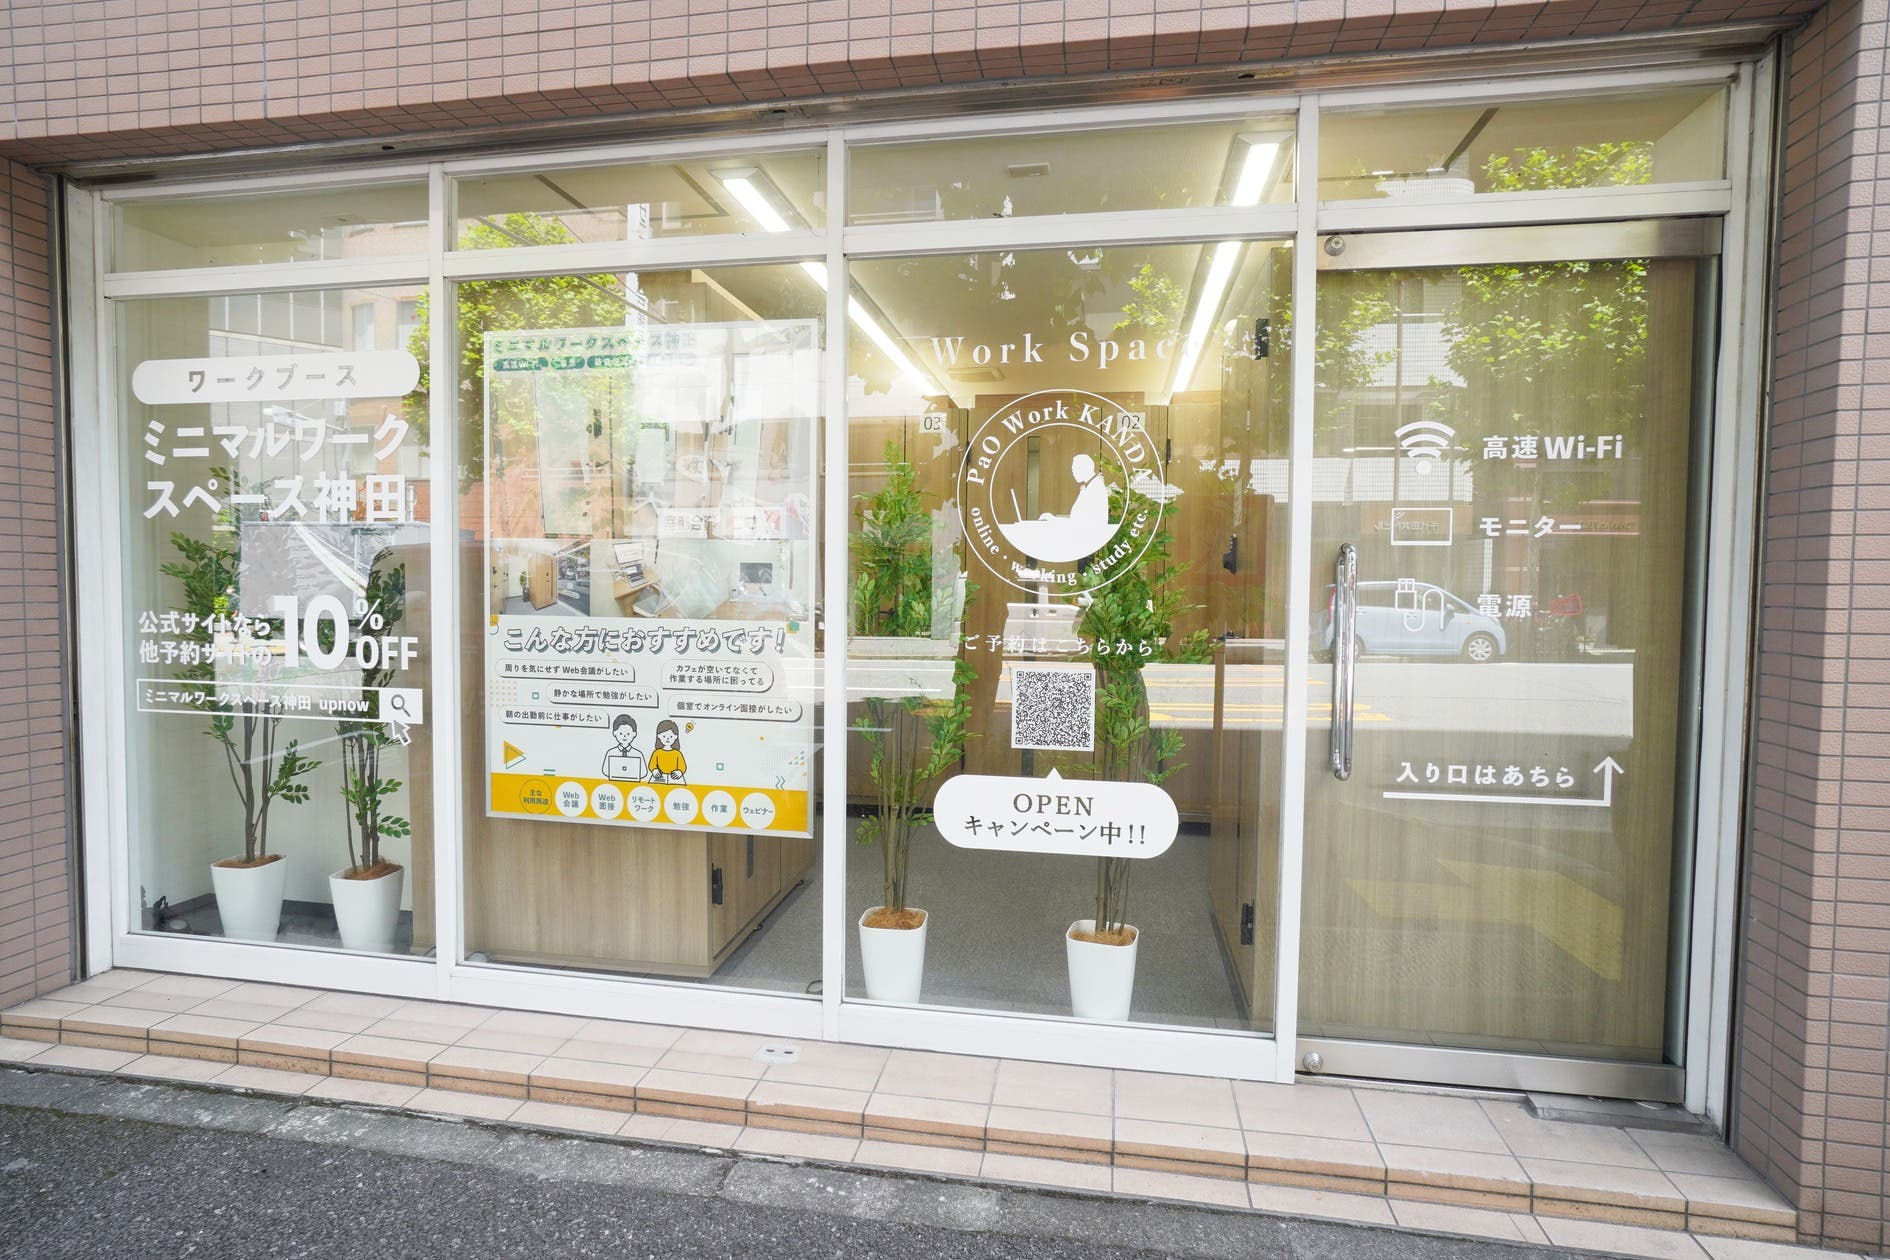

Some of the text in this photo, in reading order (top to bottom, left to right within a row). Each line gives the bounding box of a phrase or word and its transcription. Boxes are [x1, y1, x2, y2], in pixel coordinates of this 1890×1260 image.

[931, 333, 1044, 366] Work
[189, 363, 357, 392] ワークブース
[924, 417, 942, 431] 03
[1121, 415, 1141, 430] 02
[144, 414, 409, 466] ミニマルワーク
[967, 436, 1001, 486] PaO
[1001, 400, 1069, 434] Work
[144, 471, 405, 524] スペース神田
[1479, 516, 1582, 538] モニター
[971, 507, 1000, 555] online
[1092, 539, 1133, 575] study
[1130, 509, 1149, 538] etc.
[1476, 594, 1533, 618] 電源
[139, 610, 271, 636] 公式サイトなら
[139, 640, 272, 665] 他予約サイトの
[355, 635, 418, 670] OFF
[964, 634, 1152, 656] ご予約はこちらから
[676, 664, 758, 676] カフェが空いてなくて
[669, 674, 765, 686] 作業する場所に困ってる
[554, 688, 652, 701] 静かな場所で勉強がしたい
[319, 699, 370, 714] upnow
[677, 701, 793, 714] 個室でオンライン面接がしたい
[505, 710, 602, 722] 朝の出勤前に仕事がしたい
[1396, 761, 1575, 788] 入り口はあちら
[562, 791, 580, 799] Web
[598, 793, 616, 802] Web
[631, 796, 656, 805] リモート
[563, 800, 579, 809] 会議
[599, 802, 615, 811] 面接
[634, 804, 654, 813] ワーク
[672, 802, 690, 811] 勉強
[711, 804, 728, 813] 作業
[742, 806, 774, 816] ウェビナー
[1013, 793, 1095, 816] OPEN
